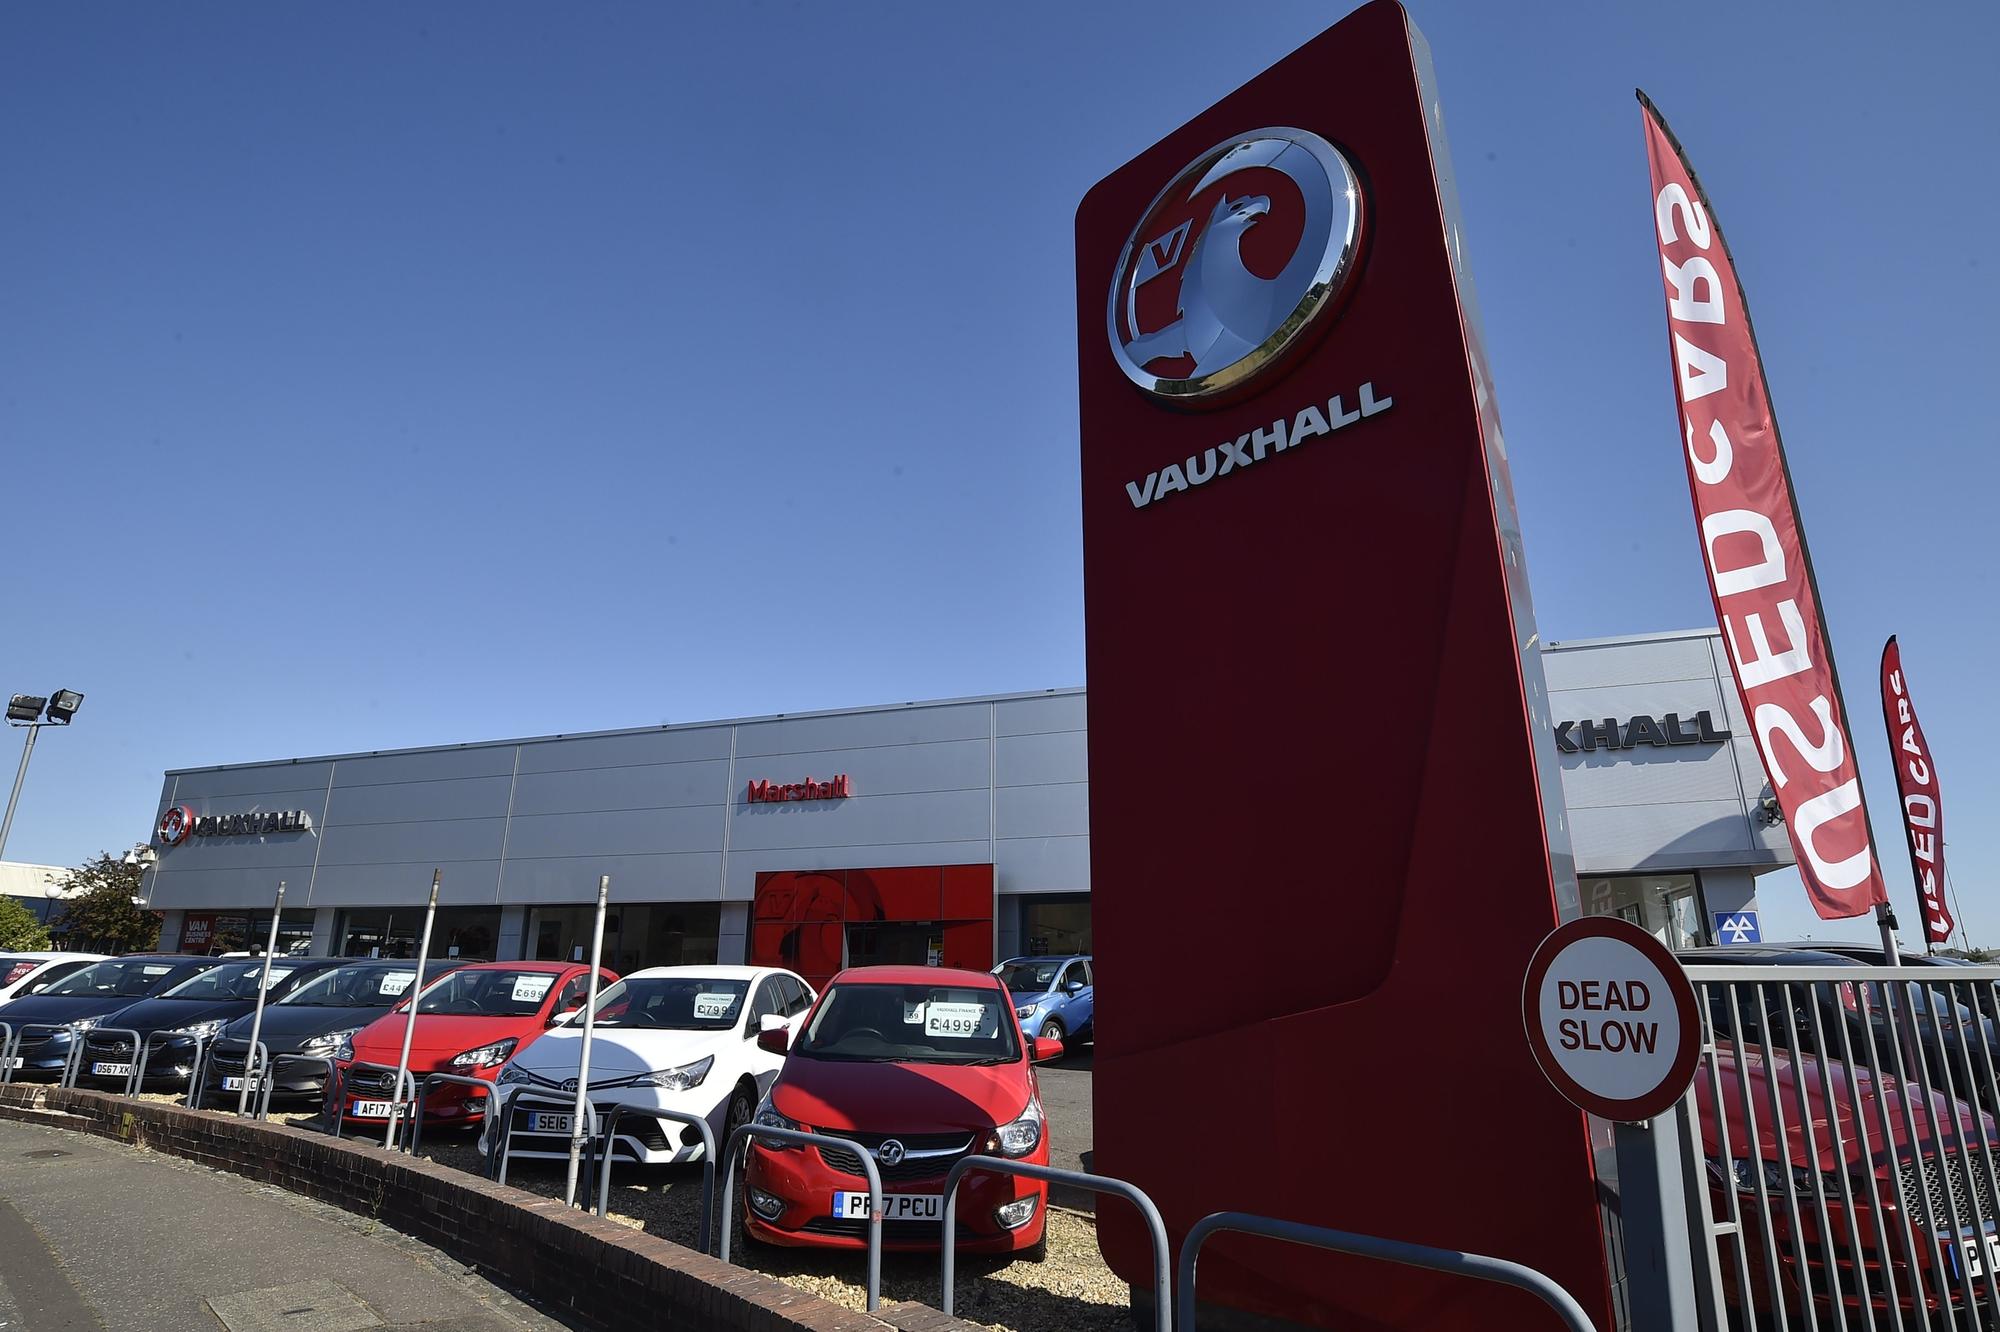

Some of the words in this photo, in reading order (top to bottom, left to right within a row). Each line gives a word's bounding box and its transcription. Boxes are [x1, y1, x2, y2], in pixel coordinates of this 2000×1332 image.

[1125, 381, 1393, 509] VAUXHALL
[1889, 669, 1930, 786] CARS
[747, 774, 848, 803] Marshall
[191, 810, 306, 837] VAUXHALL
[1903, 794, 1947, 935] USED
[188, 920, 209, 931] VAN
[1557, 980, 1651, 1012] DEAD
[697, 1004, 736, 1016] £7995
[929, 1018, 981, 1032] £4995
[1559, 1018, 1658, 1054] SLOW
[96, 1063, 118, 1075] DS67
[361, 1102, 386, 1115] AF17
[539, 1115, 568, 1130] SE16
[899, 1198, 937, 1217] PCU
